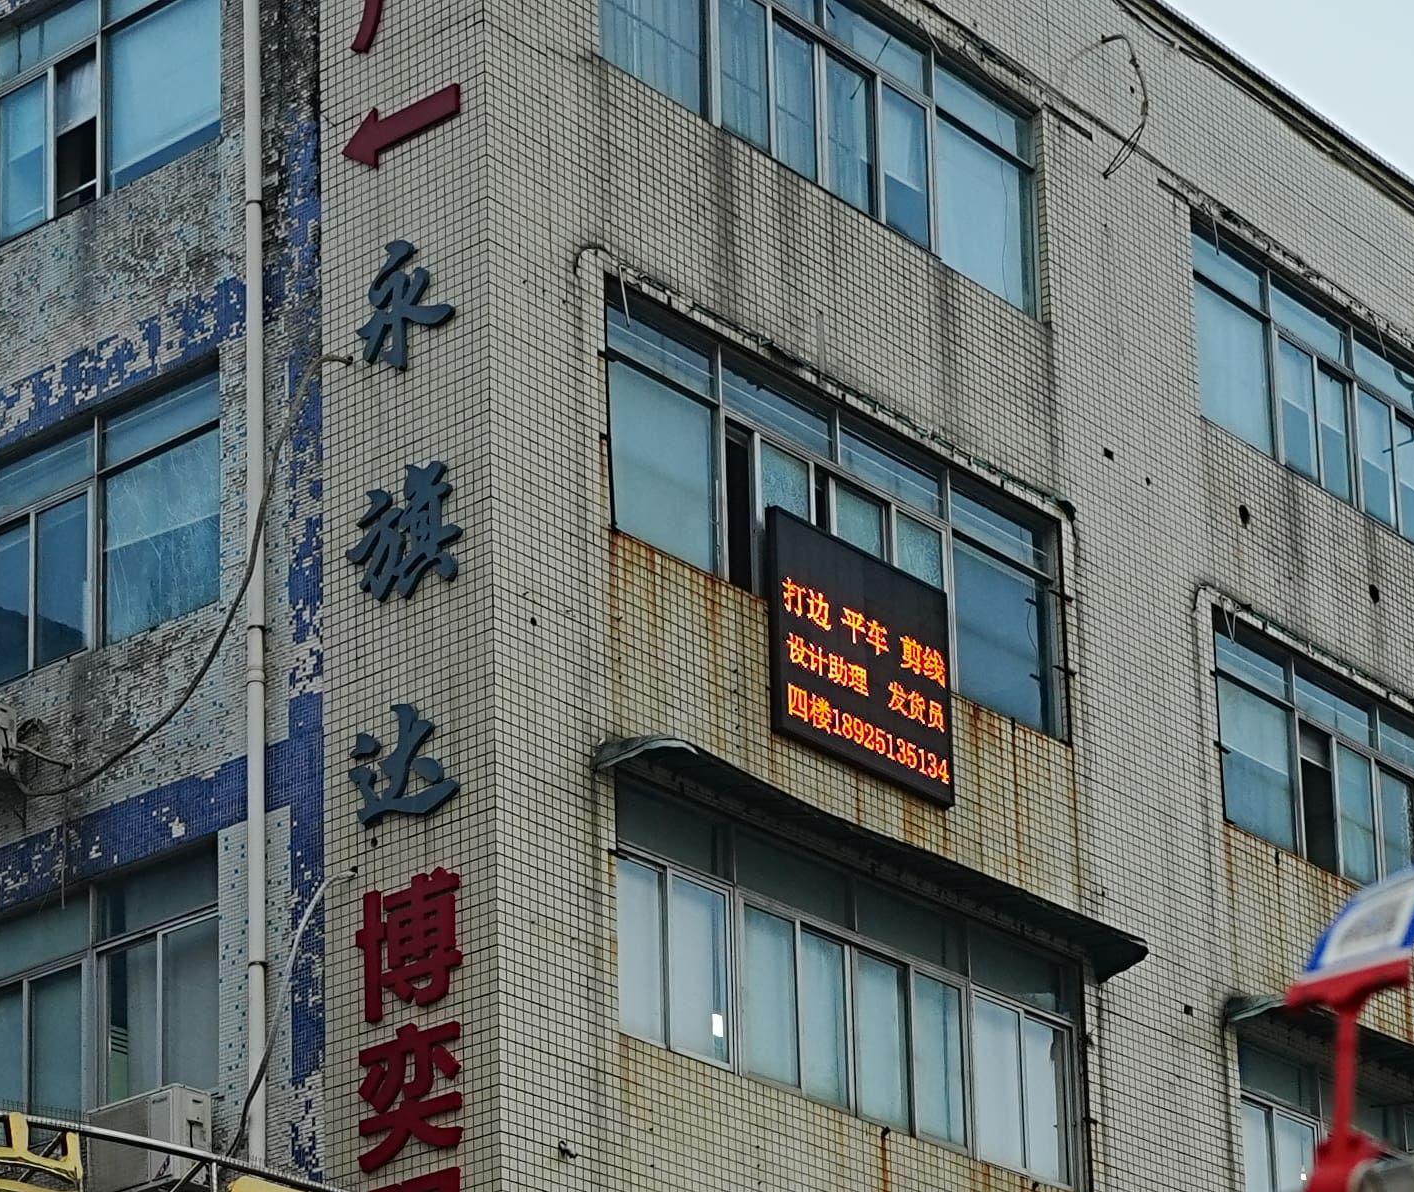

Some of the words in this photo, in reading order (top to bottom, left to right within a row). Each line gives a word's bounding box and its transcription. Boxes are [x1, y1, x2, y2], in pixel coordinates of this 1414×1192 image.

[345, 239, 462, 828] 永旗达
[782, 577, 833, 633] 打边
[841, 606, 890, 657] 平车
[899, 635, 947, 689] 剪线
[786, 634, 870, 697] 设计助理
[888, 681, 946, 733] 发货员
[787, 682, 951, 786] 四楼18925135134
